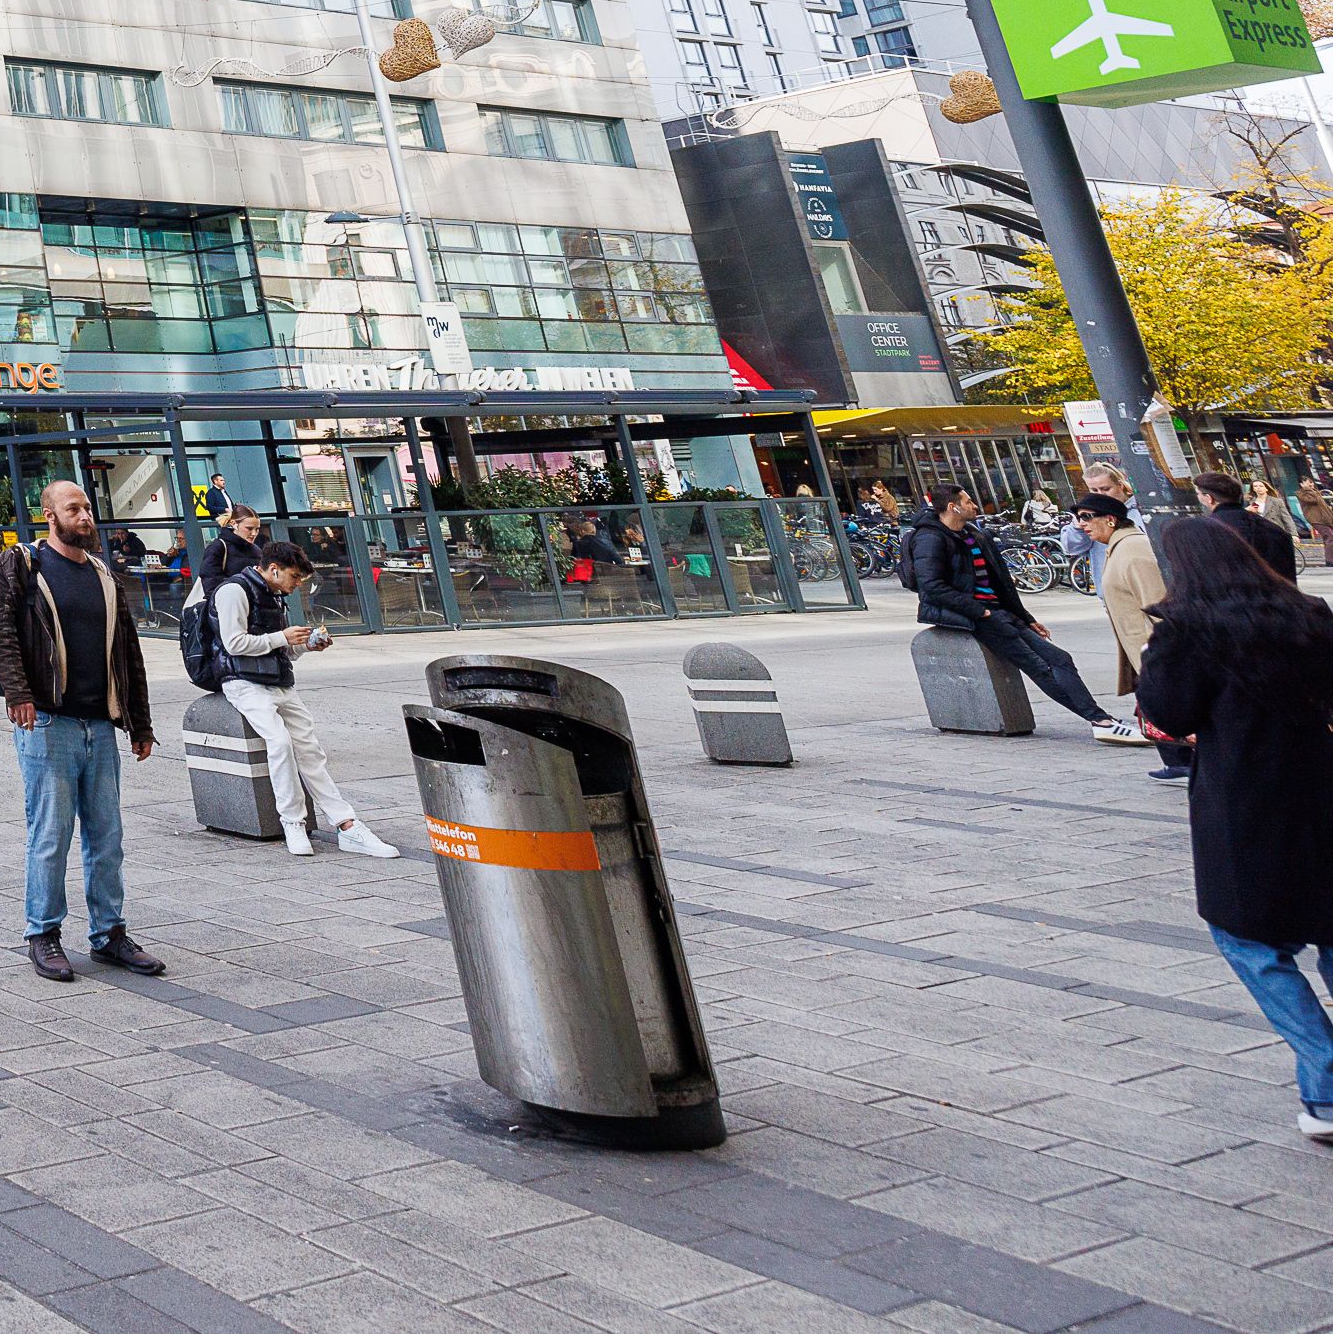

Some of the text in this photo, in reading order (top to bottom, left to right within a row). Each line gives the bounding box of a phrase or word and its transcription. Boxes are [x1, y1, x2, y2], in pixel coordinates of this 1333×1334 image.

[1223, 9, 1308, 53] Express
[867, 322, 901, 334] OFFICE
[871, 335, 908, 347] CENTER
[875, 349, 911, 357] STADTPARK
[451, 842, 465, 857] 48
